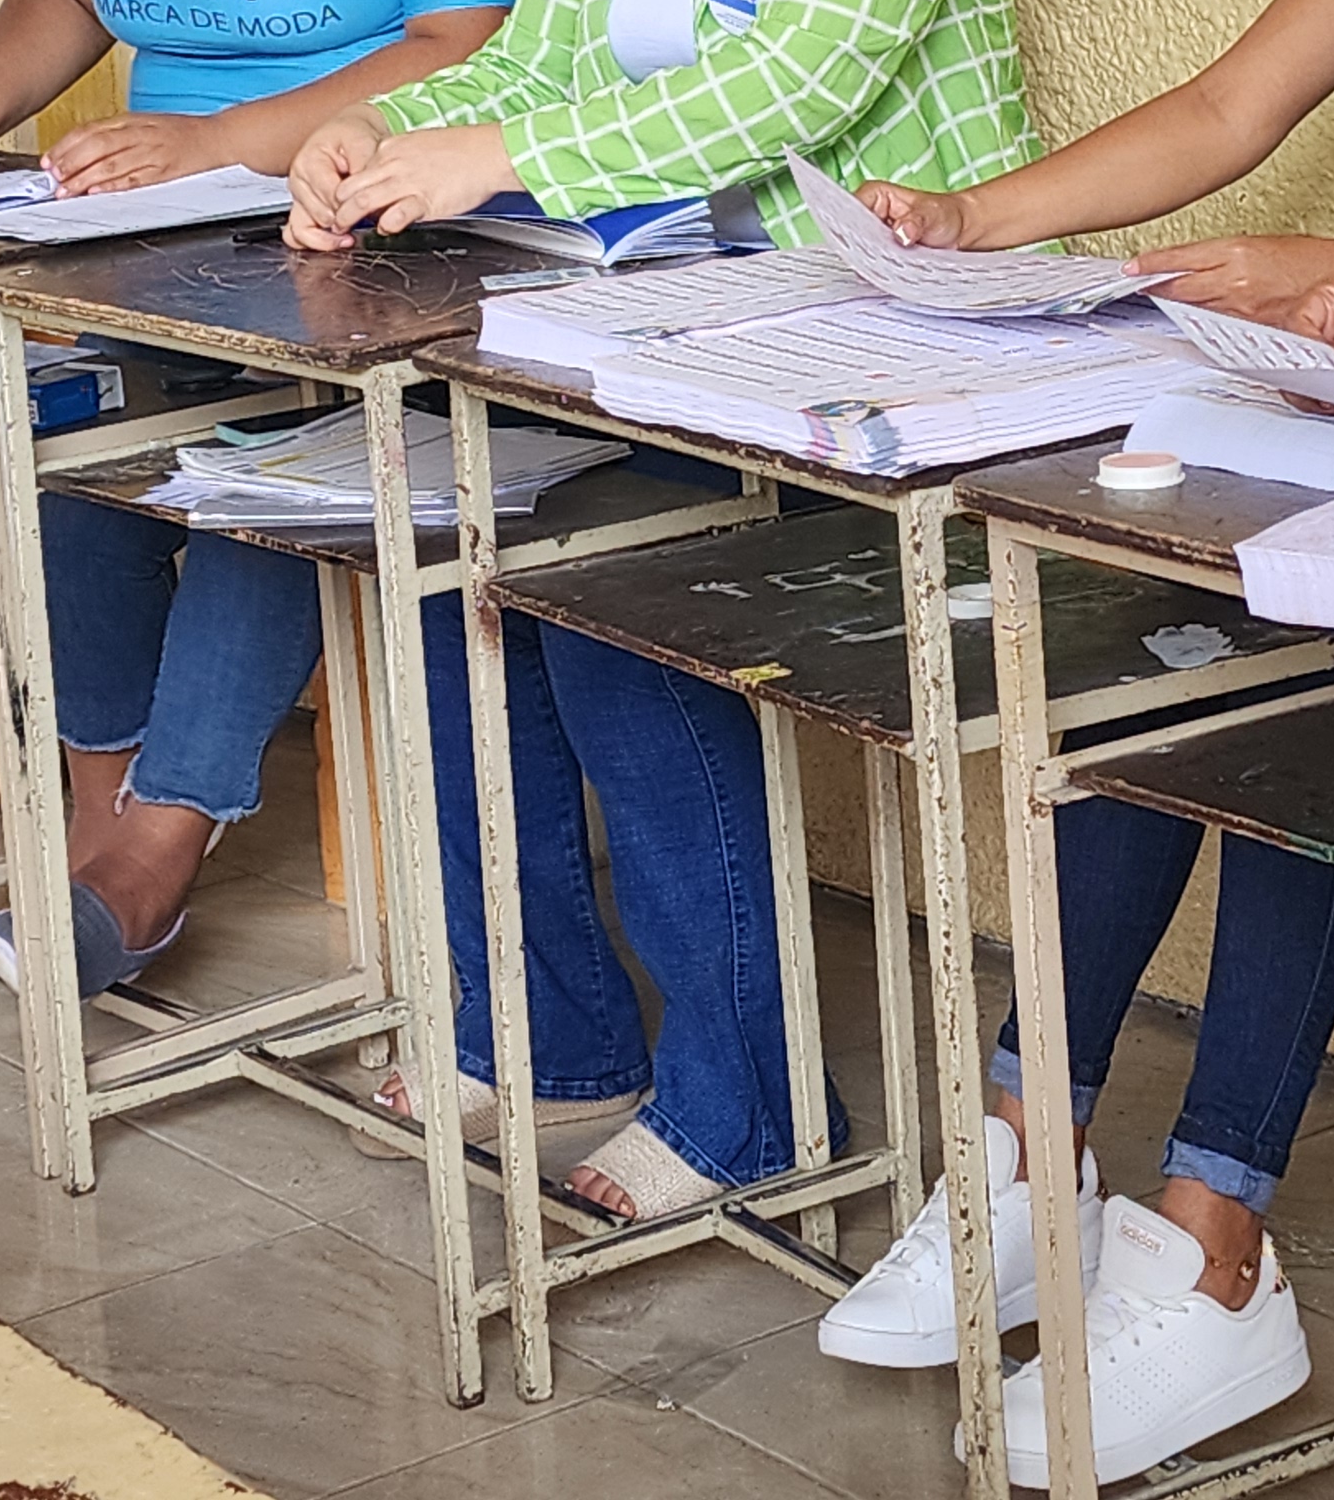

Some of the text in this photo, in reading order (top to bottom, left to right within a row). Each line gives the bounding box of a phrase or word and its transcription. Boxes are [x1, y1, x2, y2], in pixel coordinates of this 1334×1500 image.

[189, 7, 231, 33] DE
[236, 3, 344, 38] MODA
[1120, 1224, 1162, 1252] adidas
